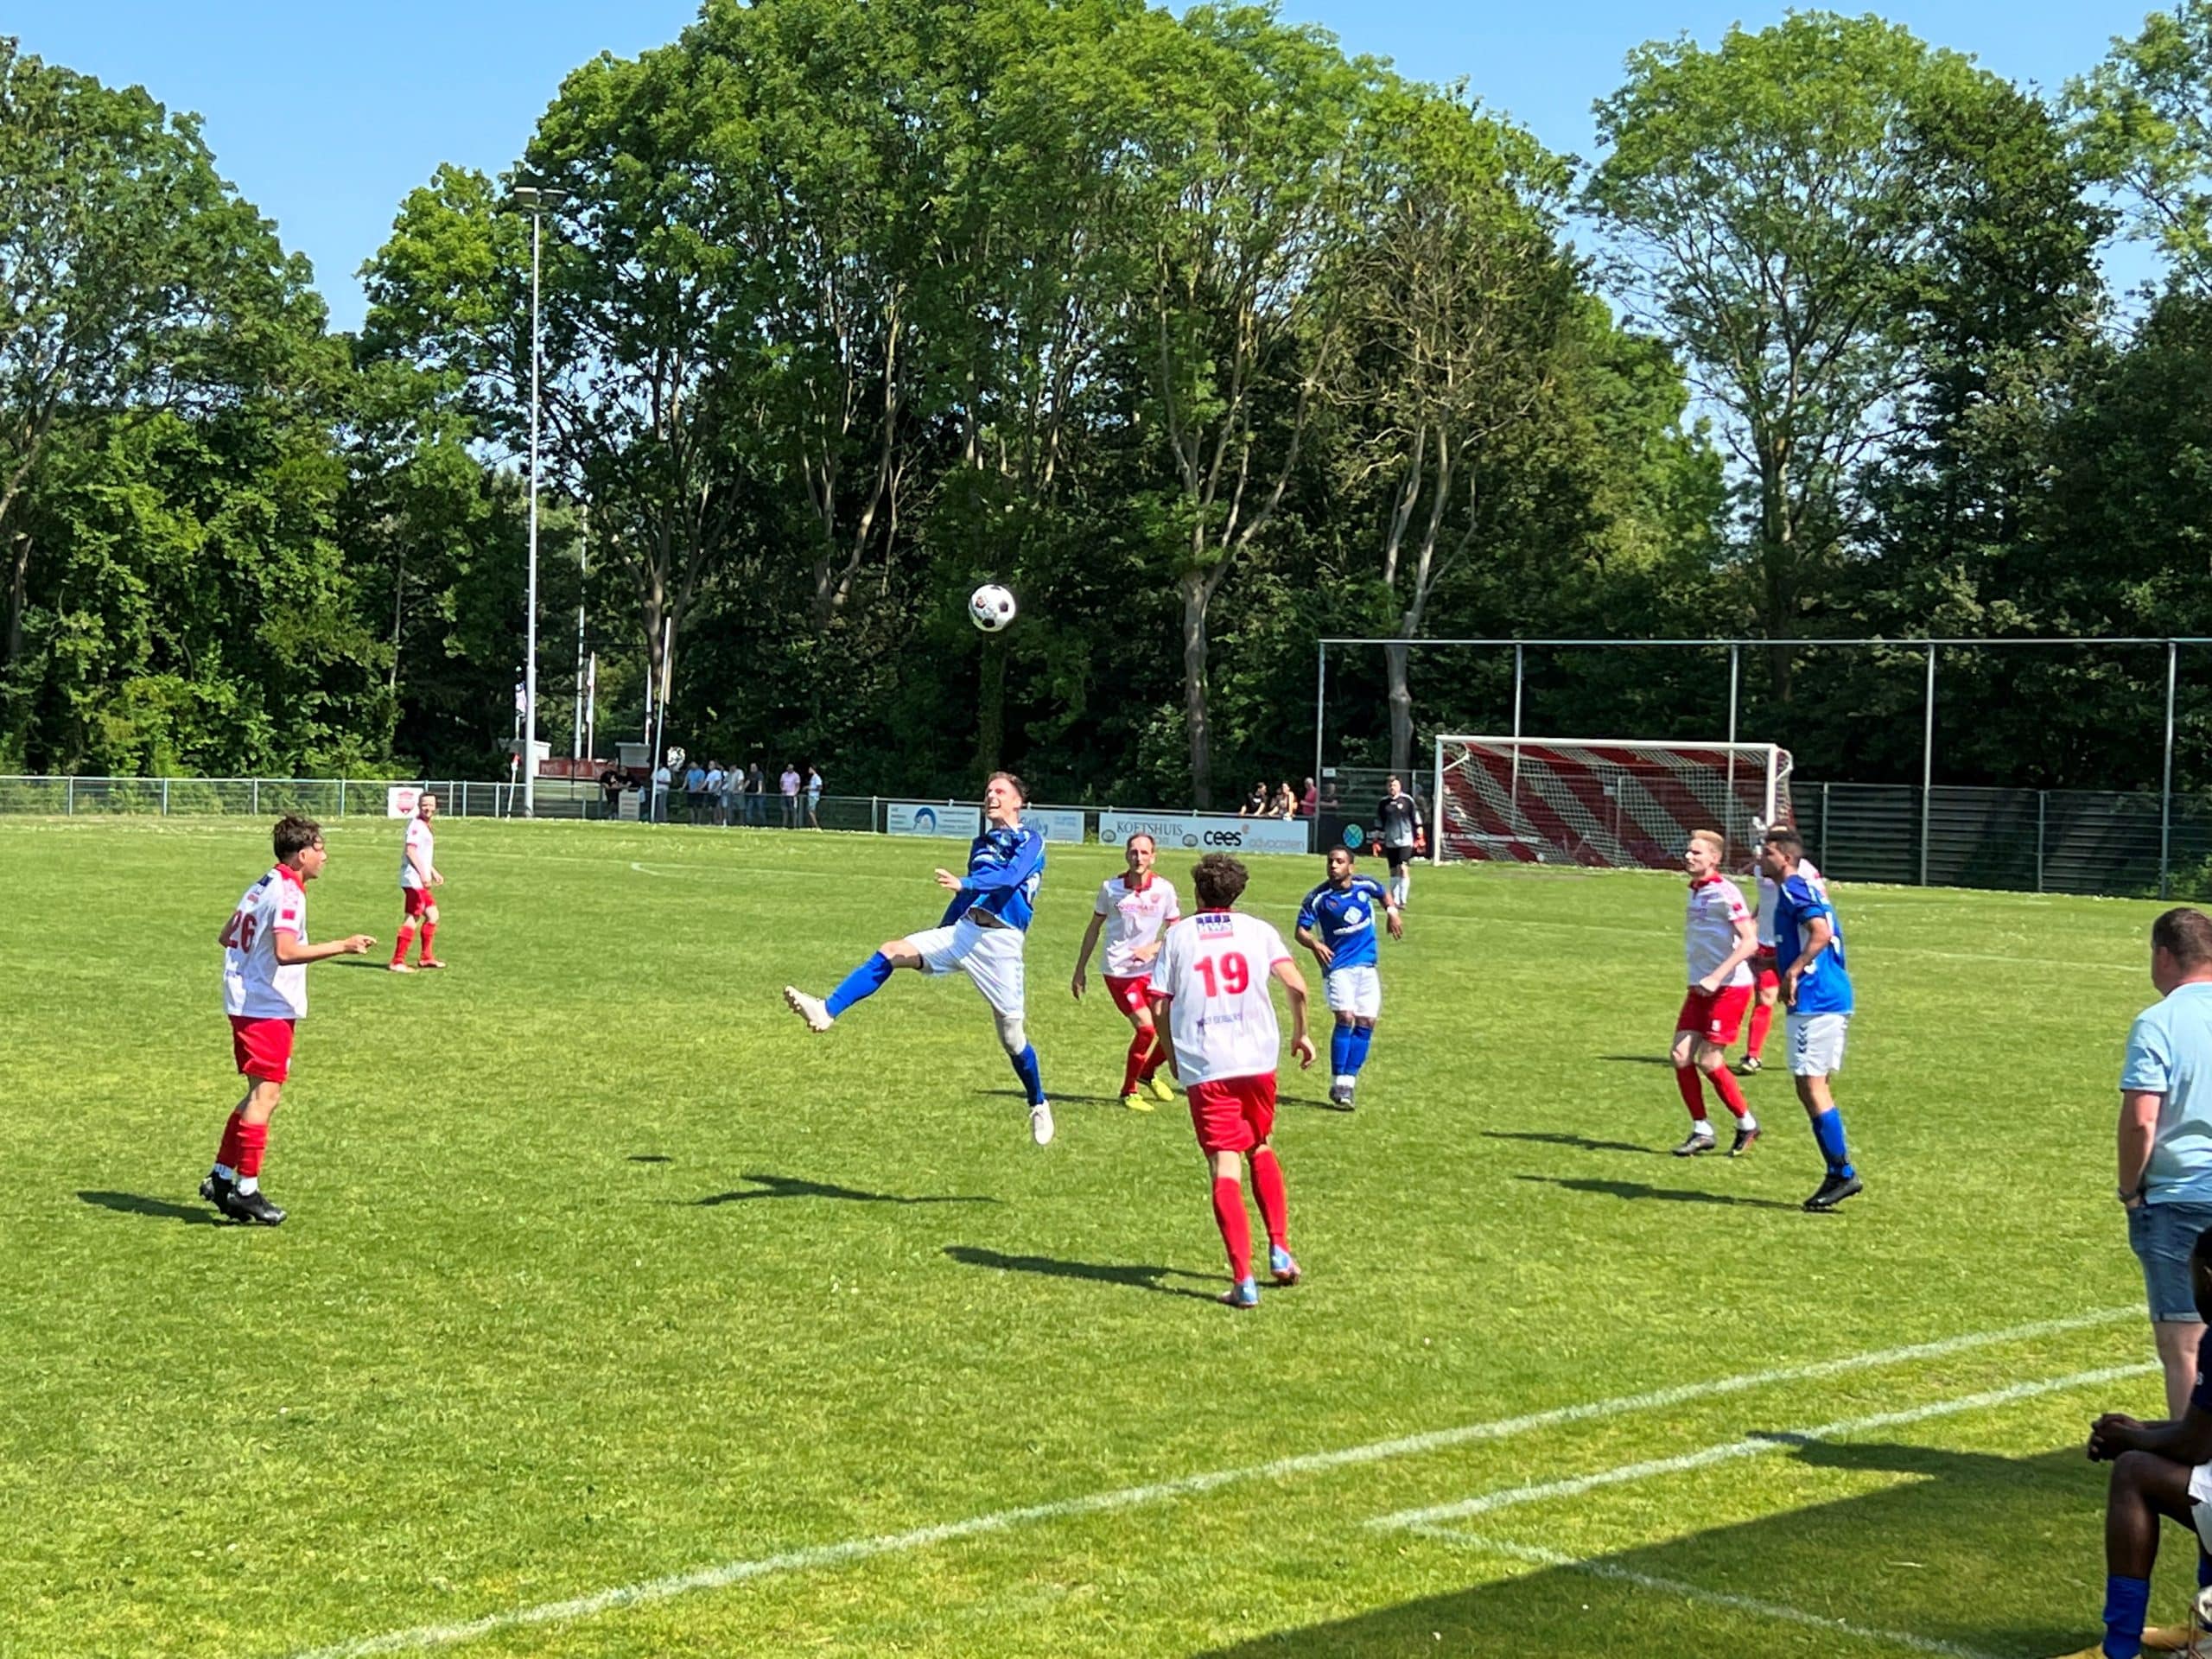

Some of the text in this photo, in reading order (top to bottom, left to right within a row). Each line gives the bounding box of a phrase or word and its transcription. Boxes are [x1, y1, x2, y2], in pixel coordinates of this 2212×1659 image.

[1116, 821, 1183, 836] KOETSHUIS
[1204, 830, 1242, 846] cees
[225, 910, 257, 954] 26
[1194, 951, 1249, 998] 19
